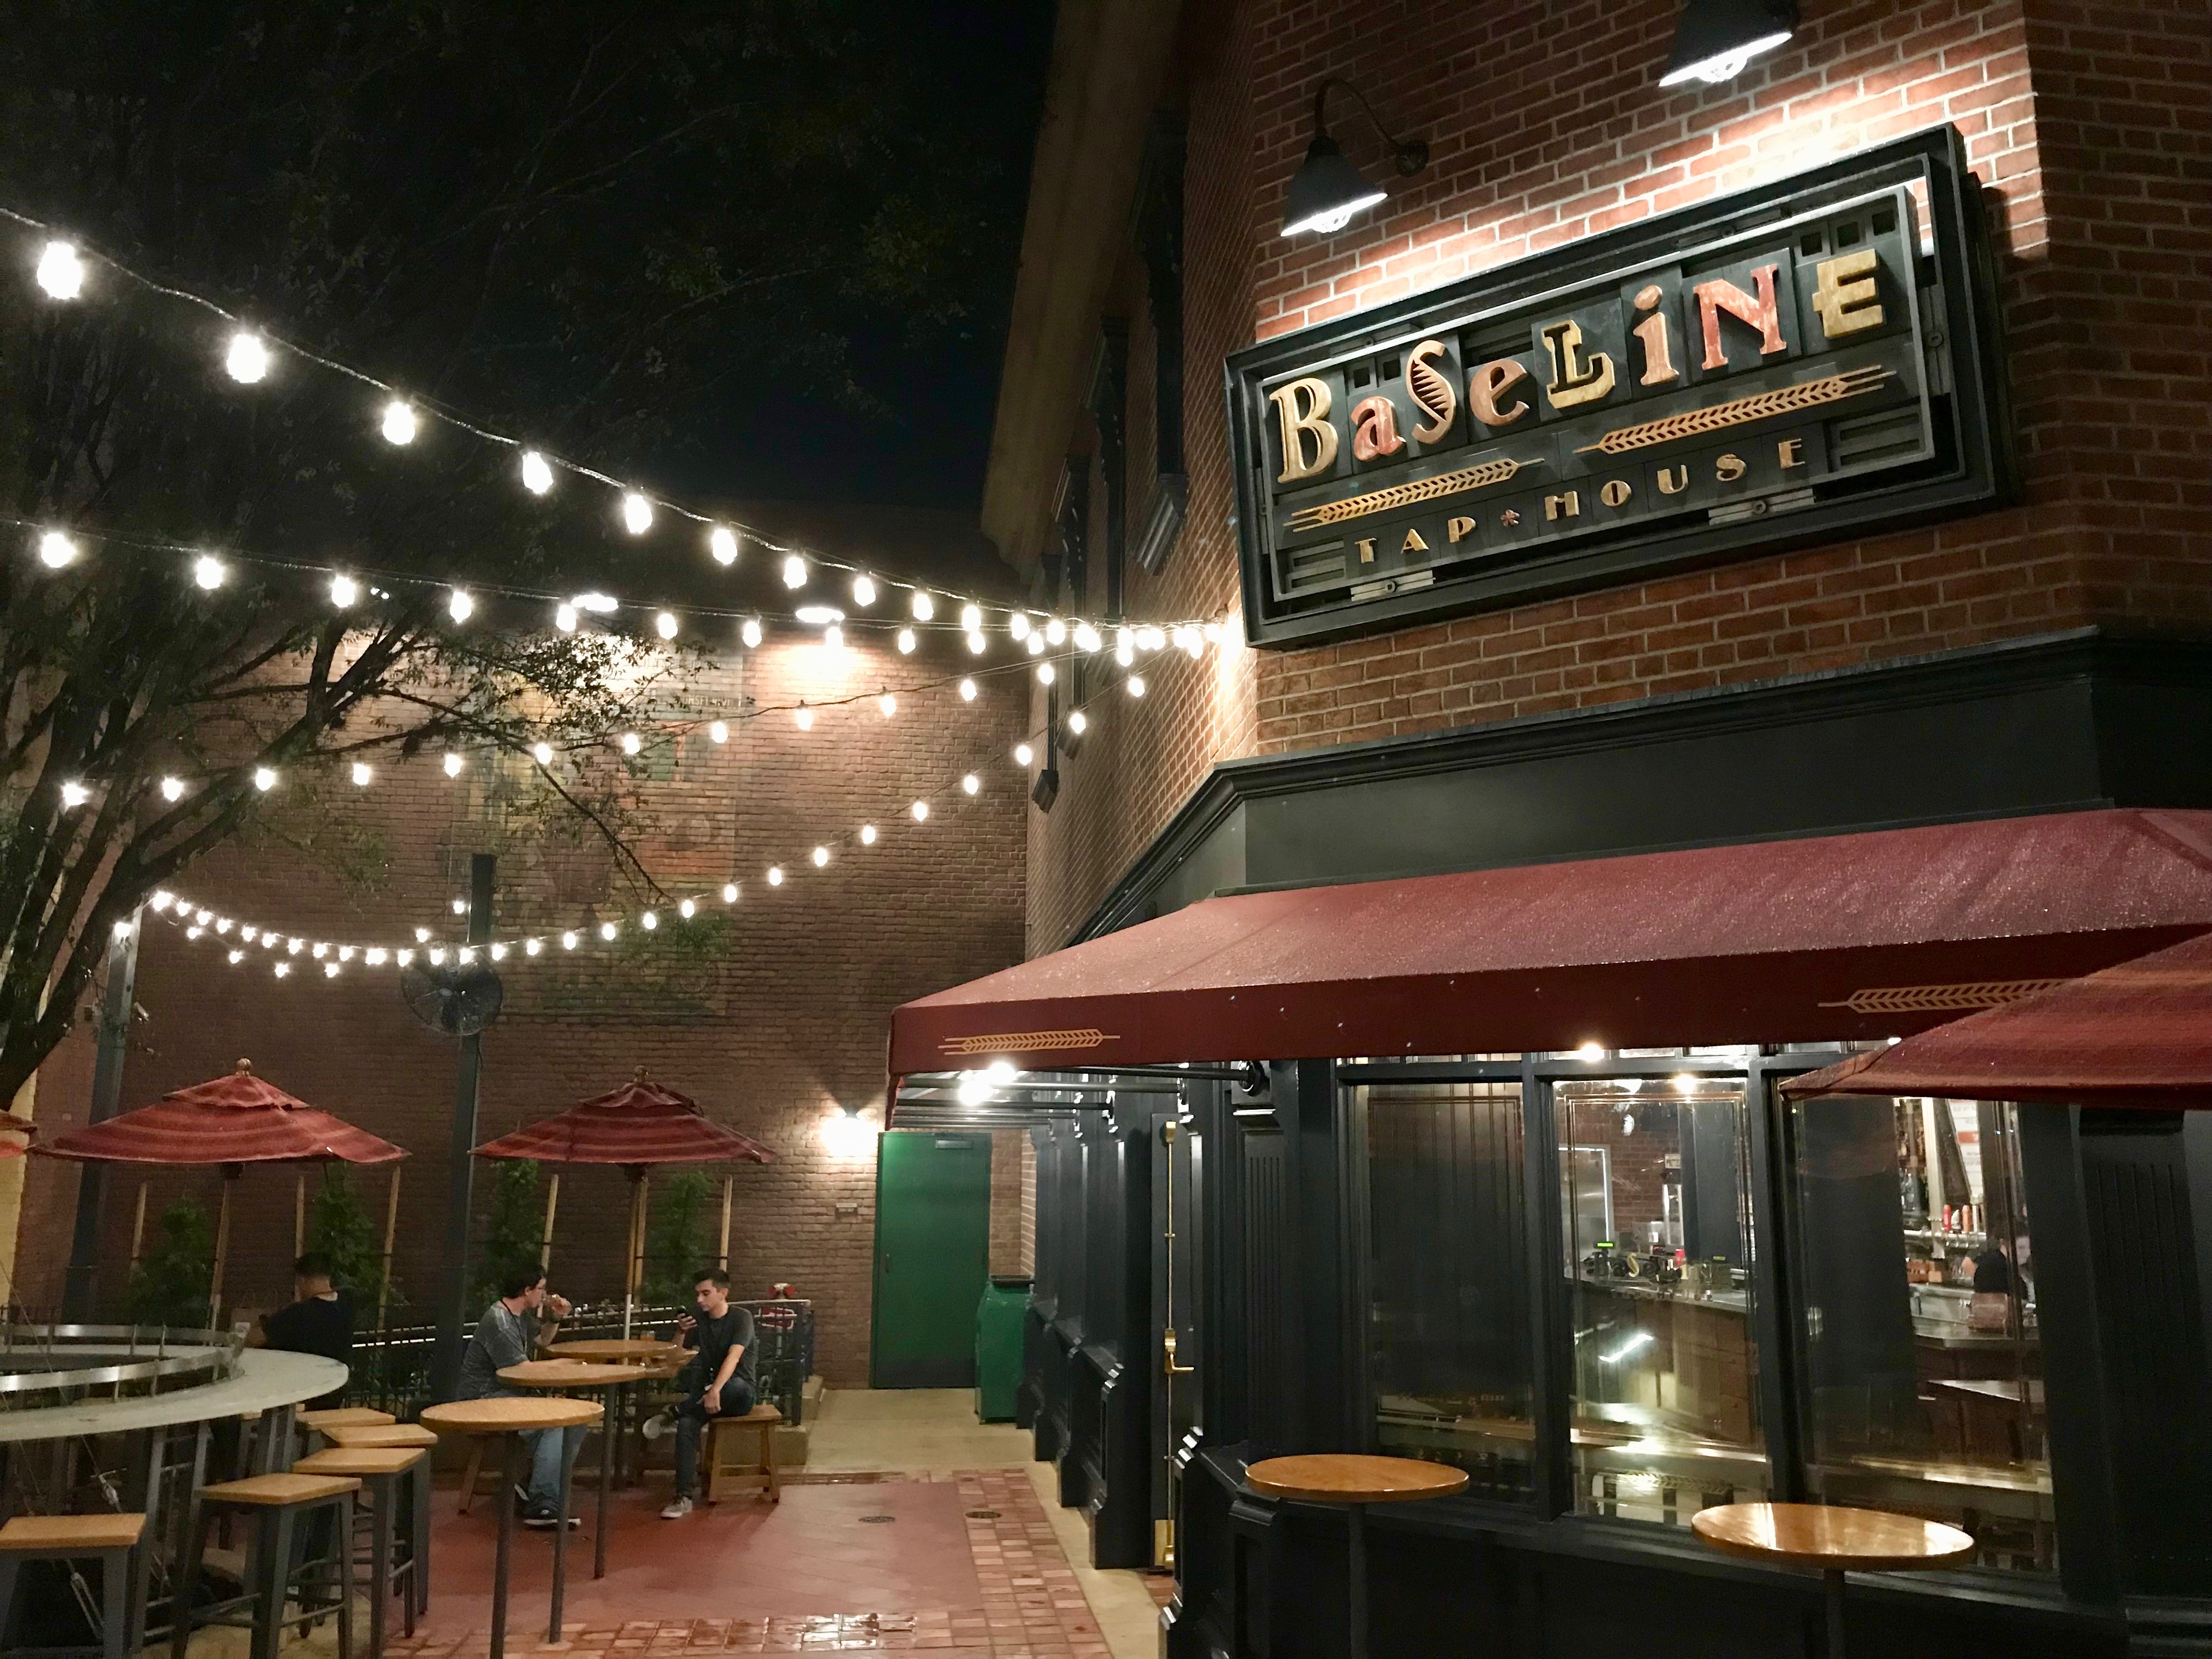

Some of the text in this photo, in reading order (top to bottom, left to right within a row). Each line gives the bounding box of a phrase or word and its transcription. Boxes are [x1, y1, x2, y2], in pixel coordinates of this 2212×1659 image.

[1354, 438, 1807, 563] TAP HOUSE
[680, 695, 708, 706] UNSET
